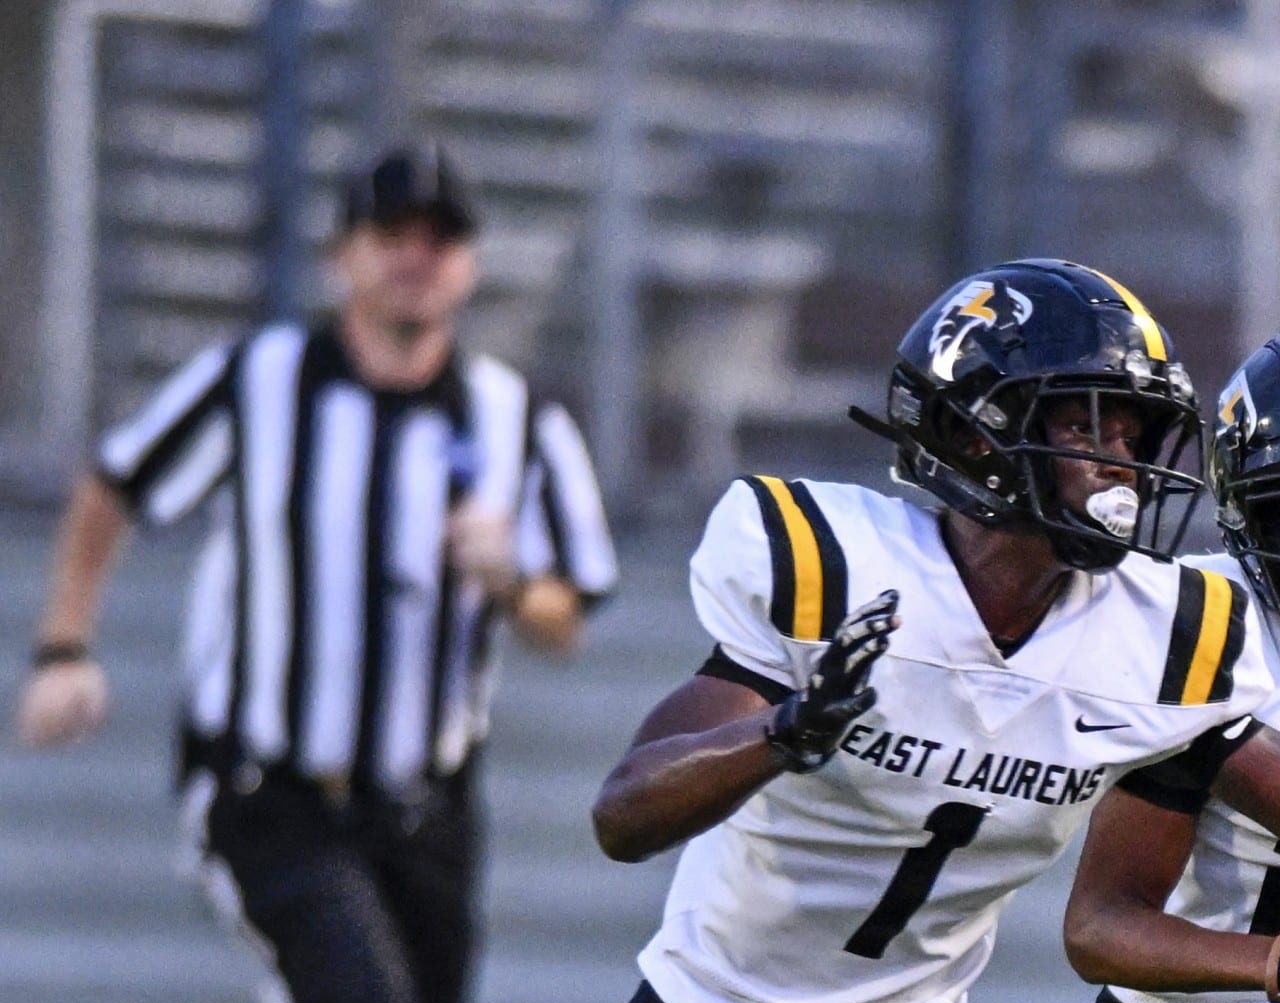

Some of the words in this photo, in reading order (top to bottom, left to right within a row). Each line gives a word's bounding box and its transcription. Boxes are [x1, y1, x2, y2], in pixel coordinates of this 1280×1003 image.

[840, 724, 943, 778] EAST
[943, 748, 1105, 806] LAURENS
[844, 801, 991, 960] 1
